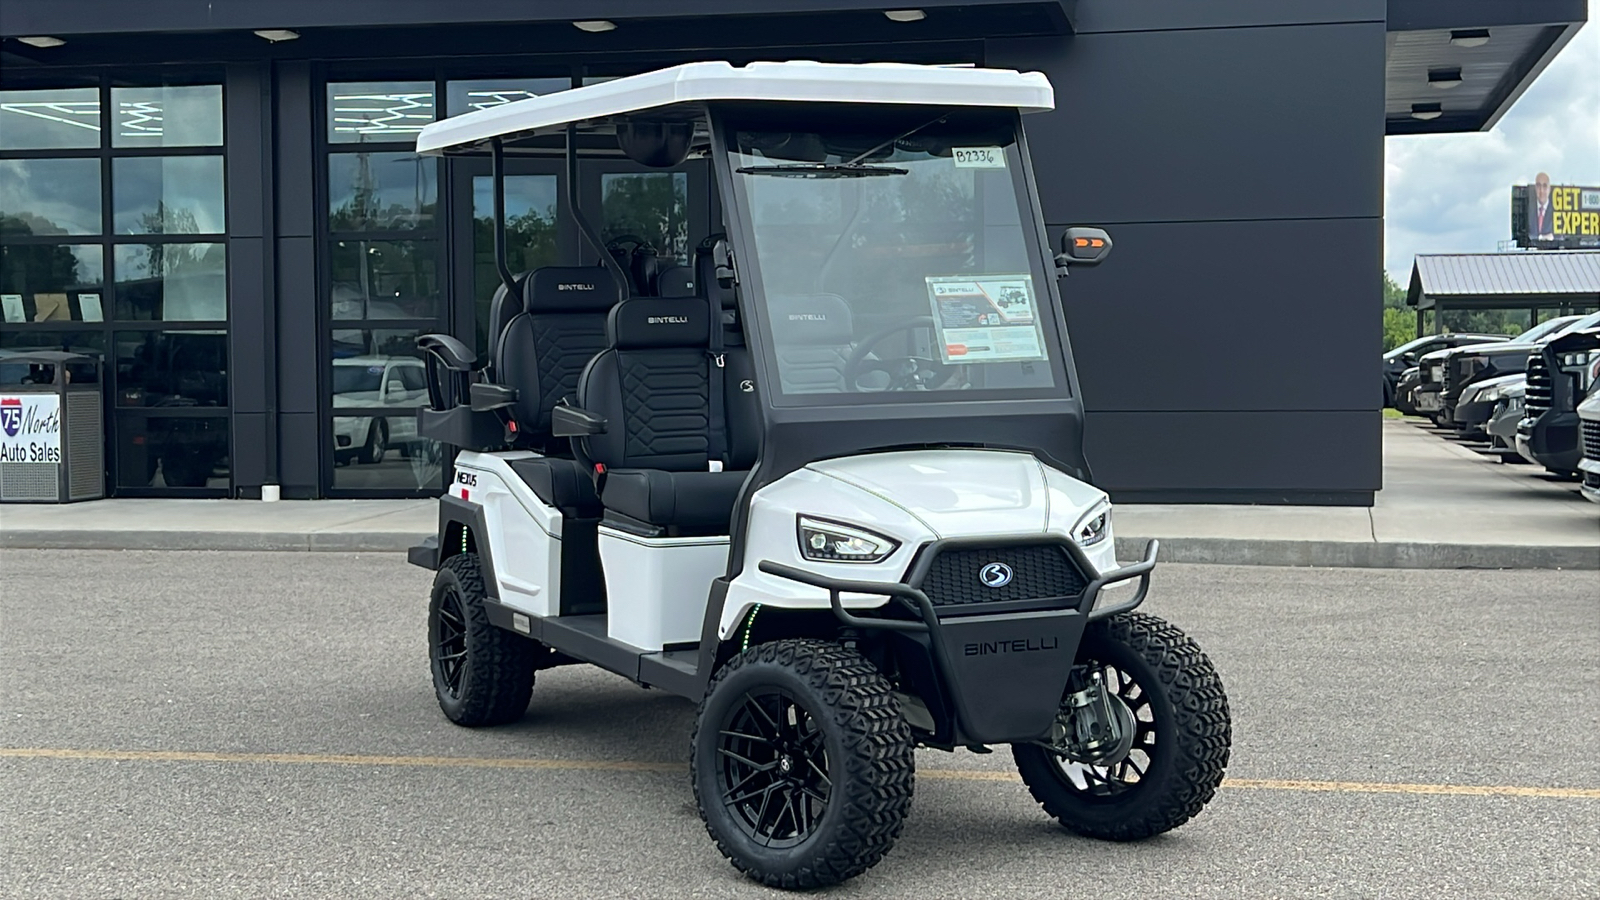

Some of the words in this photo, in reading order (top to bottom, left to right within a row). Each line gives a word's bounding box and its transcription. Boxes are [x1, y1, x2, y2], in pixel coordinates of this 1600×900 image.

[956, 150, 994, 163] B2336
[1552, 187, 1581, 211] GET
[647, 316, 688, 324] BINTELLI
[3, 409, 20, 430] 75
[22, 404, 60, 435] North
[1, 442, 27, 462] Auto
[29, 441, 60, 462] Sales
[964, 636, 1058, 656] BINTELLI
